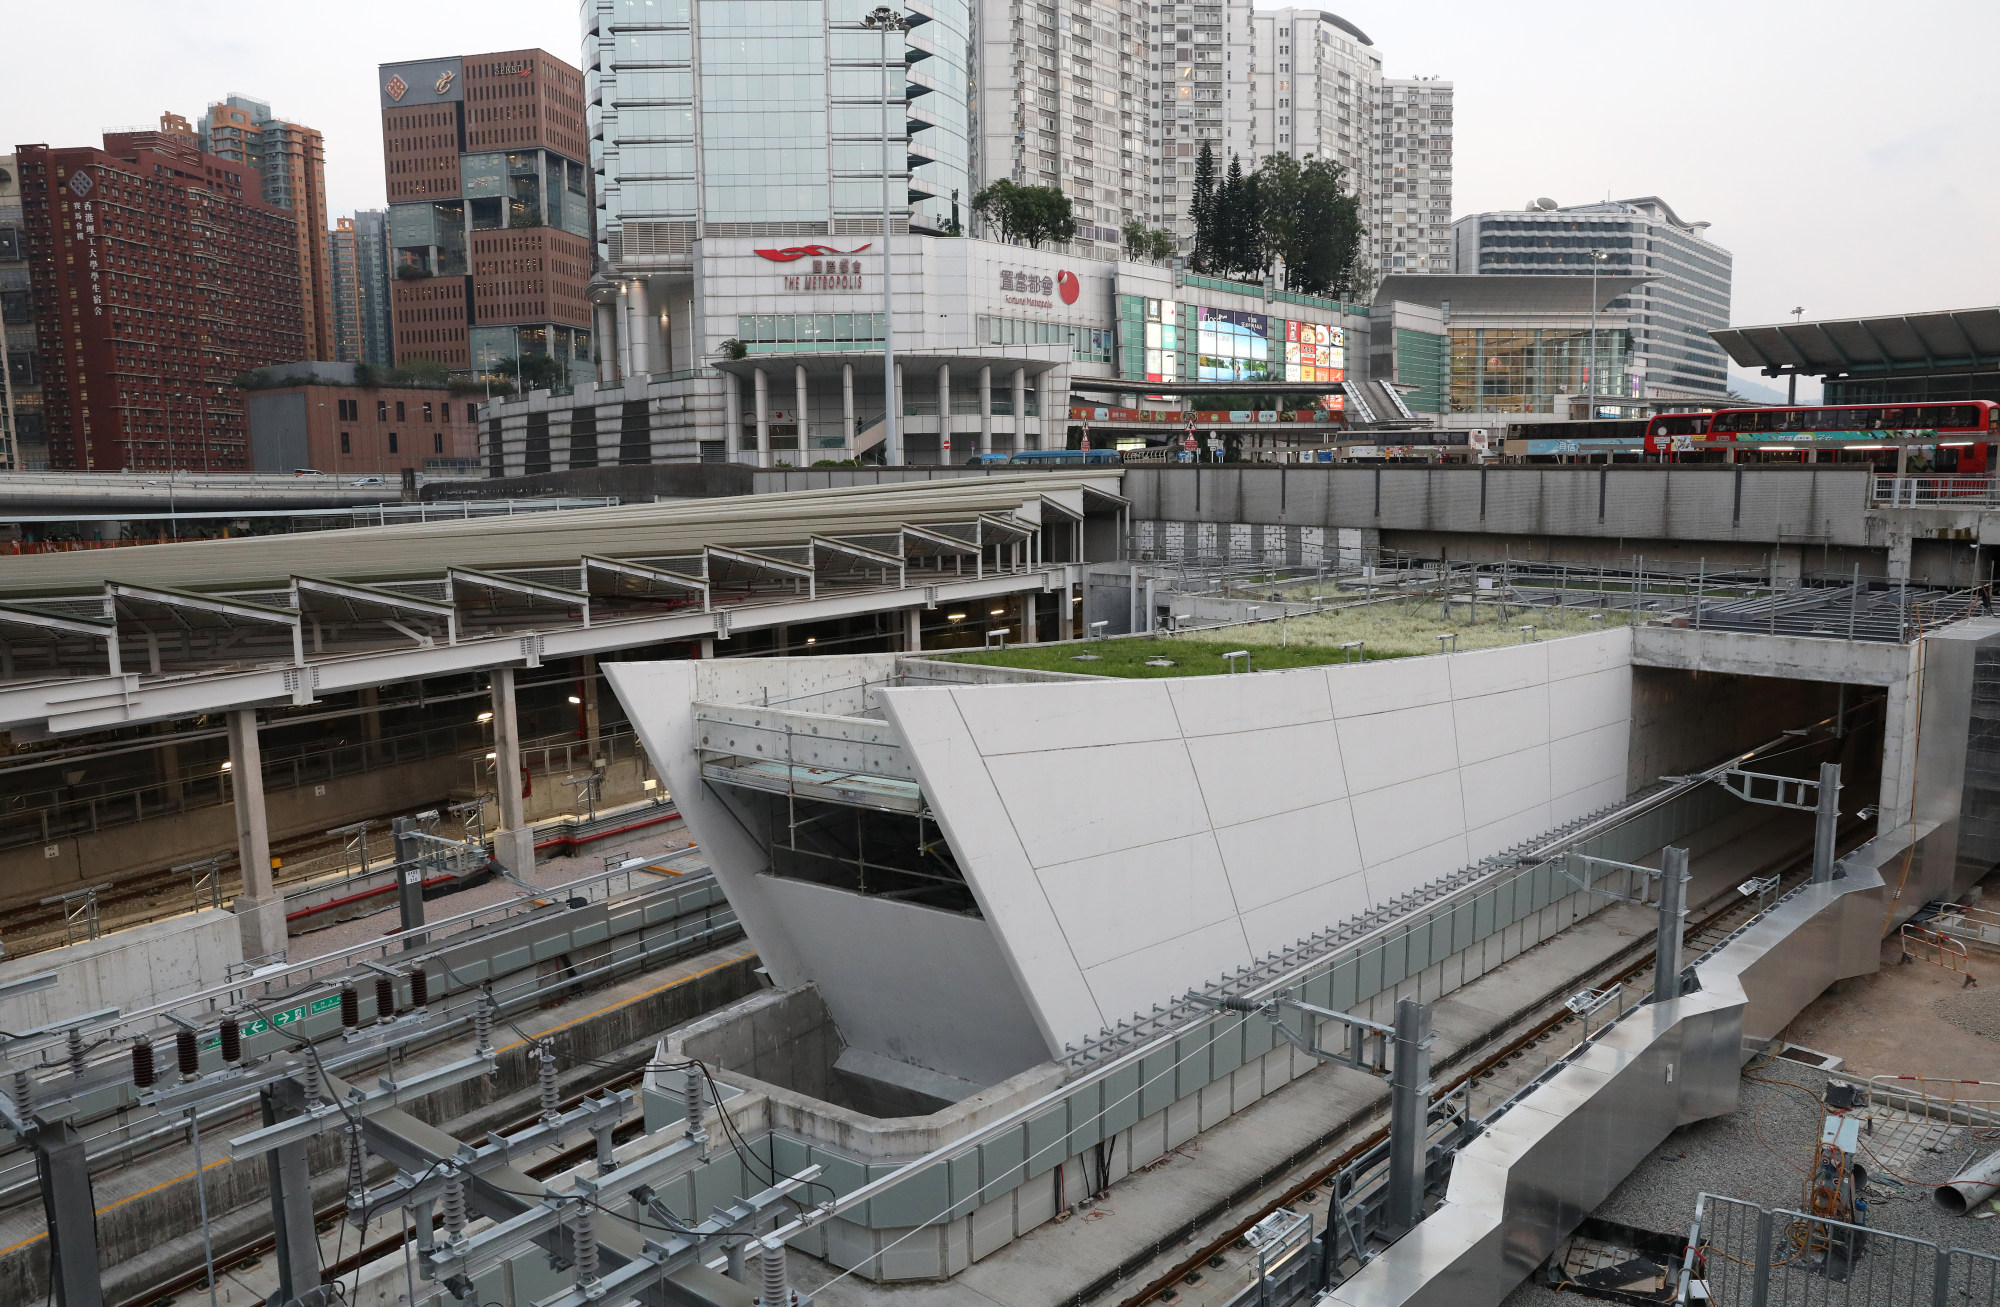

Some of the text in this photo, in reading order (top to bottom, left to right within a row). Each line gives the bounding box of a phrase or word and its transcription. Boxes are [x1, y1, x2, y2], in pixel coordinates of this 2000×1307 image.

[495, 65, 523, 75] SPEED
[84, 201, 102, 316] 香港理工大學學生宿舍
[784, 275, 862, 290] THE METROPOLIS
[1000, 269, 1053, 296] 置富都會
